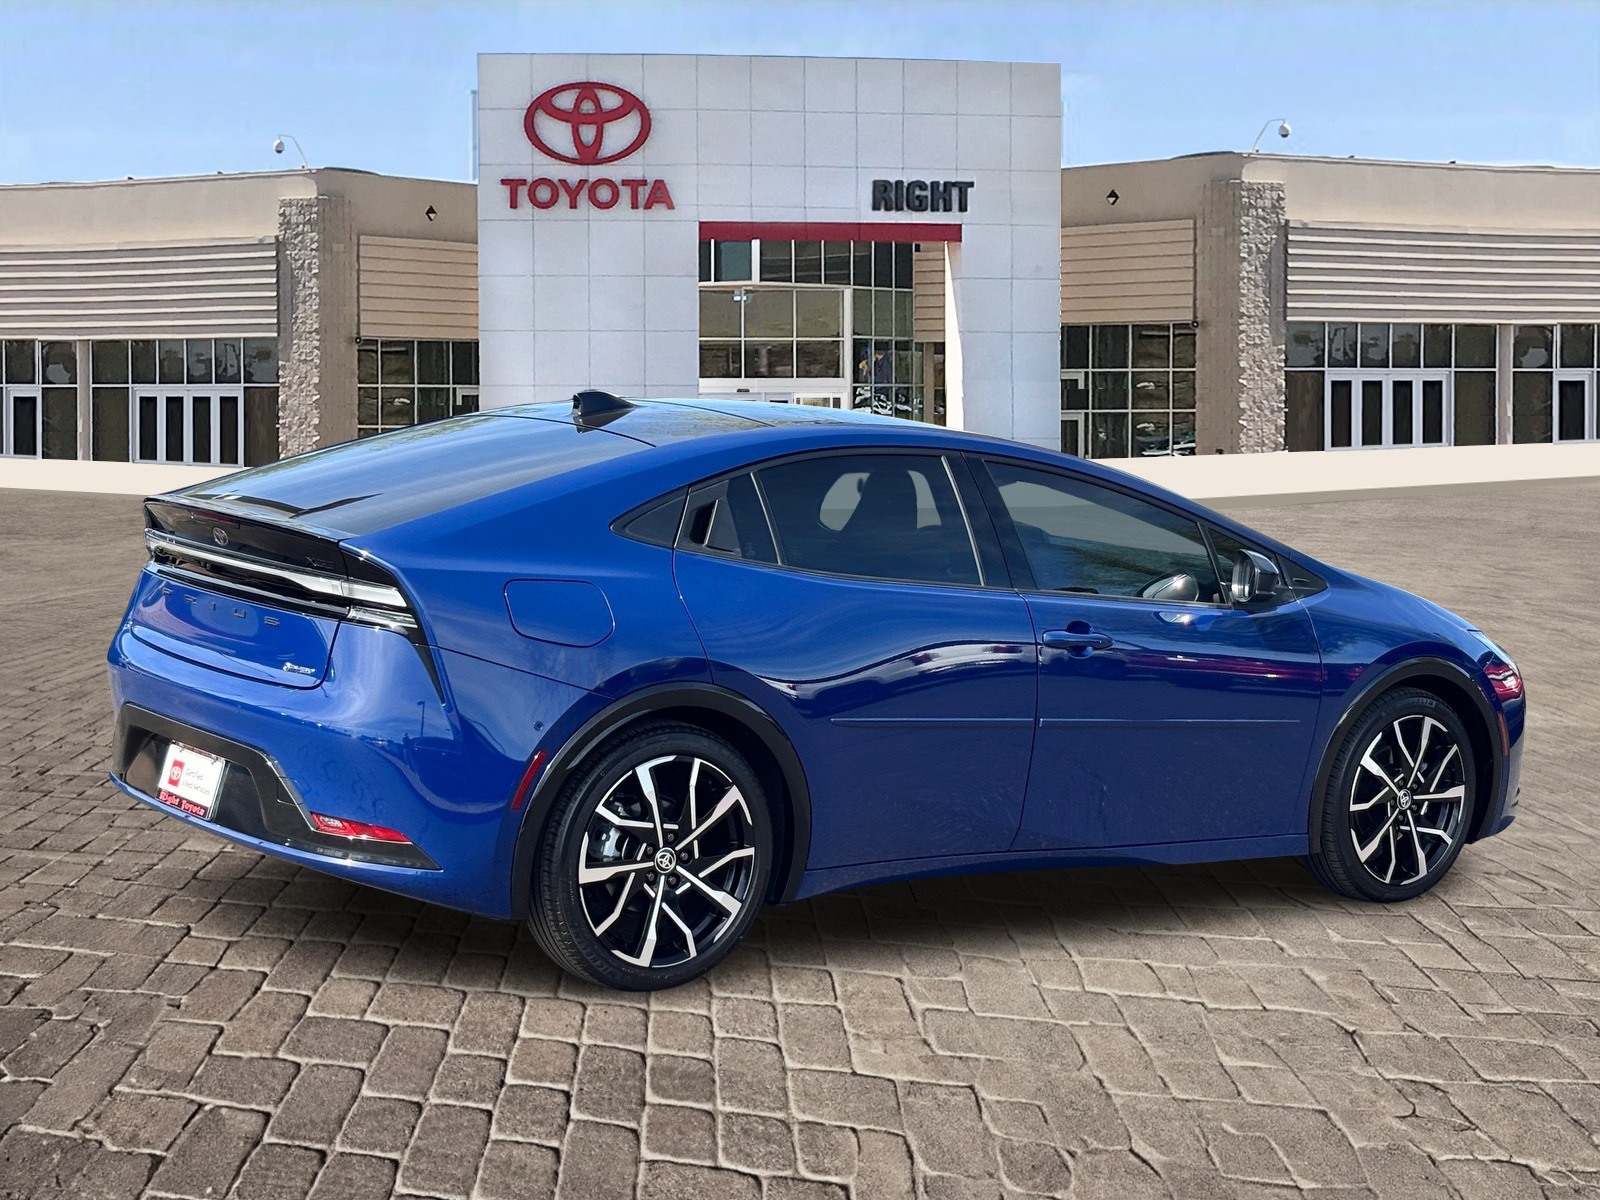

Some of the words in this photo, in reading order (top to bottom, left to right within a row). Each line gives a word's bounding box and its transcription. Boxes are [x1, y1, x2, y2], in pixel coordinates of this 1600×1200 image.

[500, 178, 675, 210] TOYOTA
[871, 179, 975, 213] RIGHT
[161, 587, 280, 627] PRIUS
[159, 789, 180, 805] Right
[181, 800, 205, 816] Toyota
